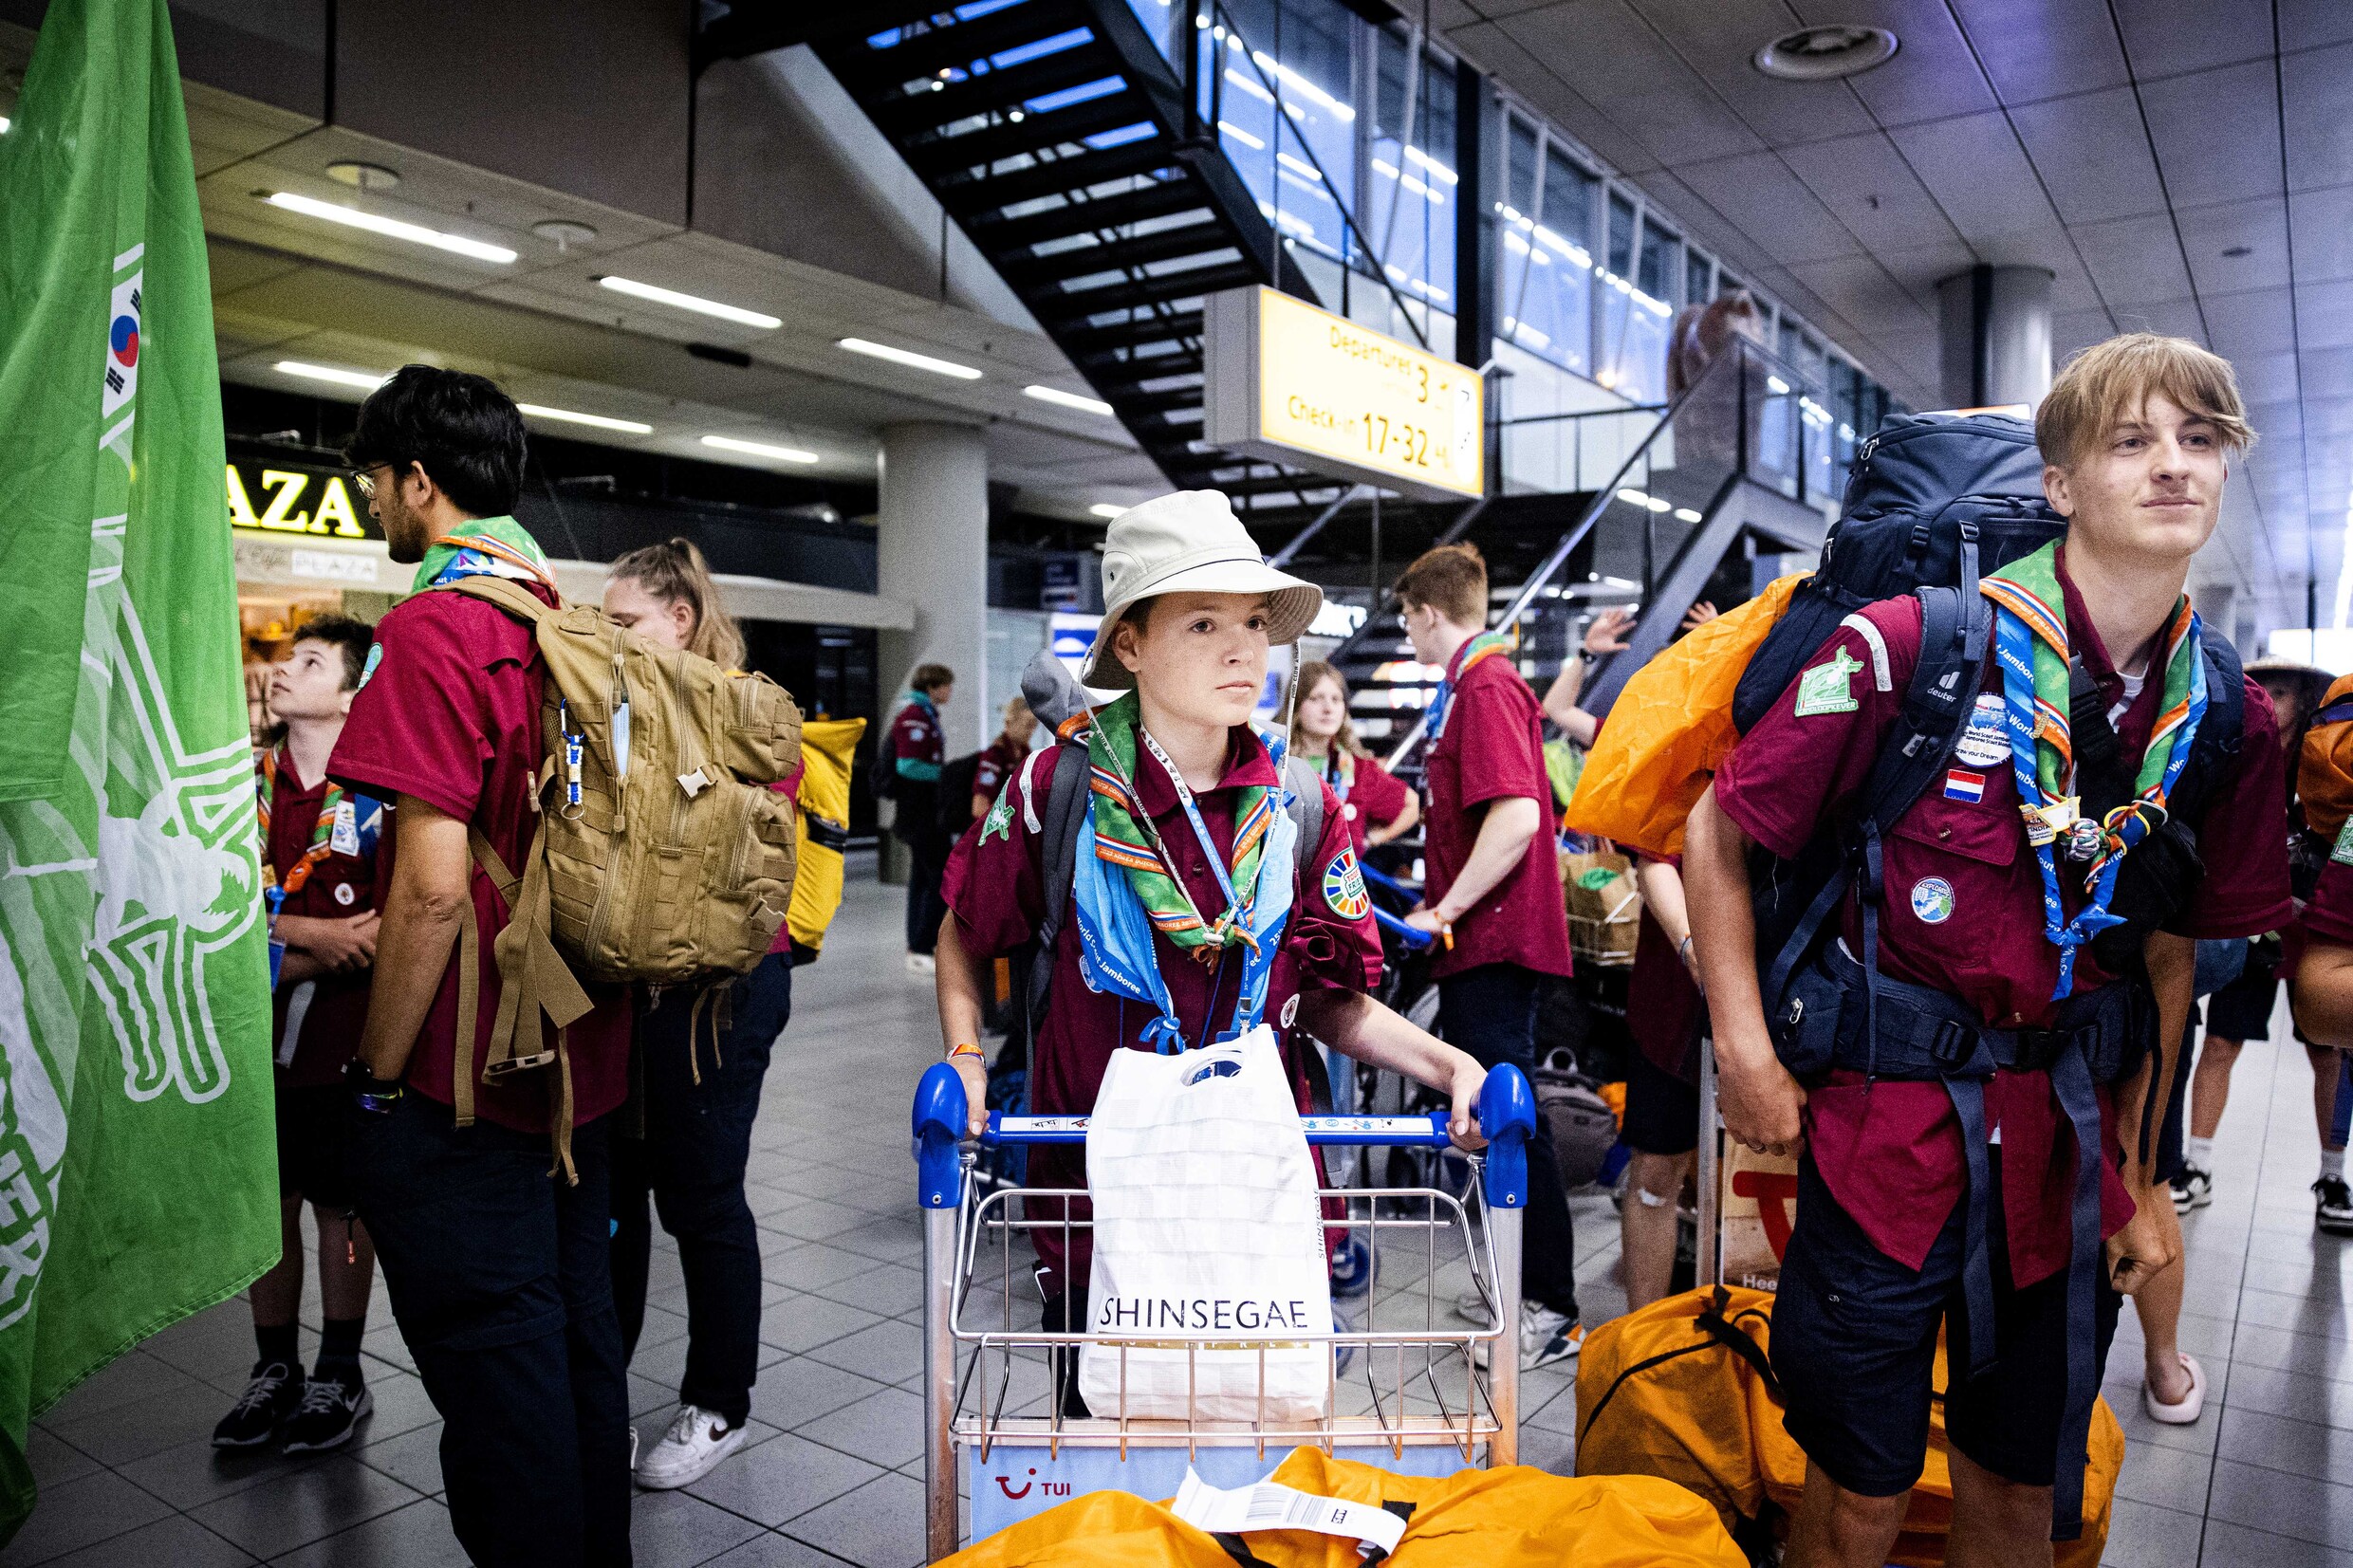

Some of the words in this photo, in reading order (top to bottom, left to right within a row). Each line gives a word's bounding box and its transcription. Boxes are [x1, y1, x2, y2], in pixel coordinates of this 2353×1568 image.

[1330, 325, 1412, 376] Departures
[1417, 365, 1429, 403] 3
[1288, 395, 1357, 434] Check-in
[1363, 413, 1428, 468] 17-32
[1926, 686, 1957, 703] deuter
[1968, 748, 1980, 757] your
[1980, 751, 1999, 761] Dream
[1100, 961, 1141, 994] Jamboree
[1101, 1297, 1308, 1329] SHINSEGAE
[1041, 1483, 1071, 1496] TUI
